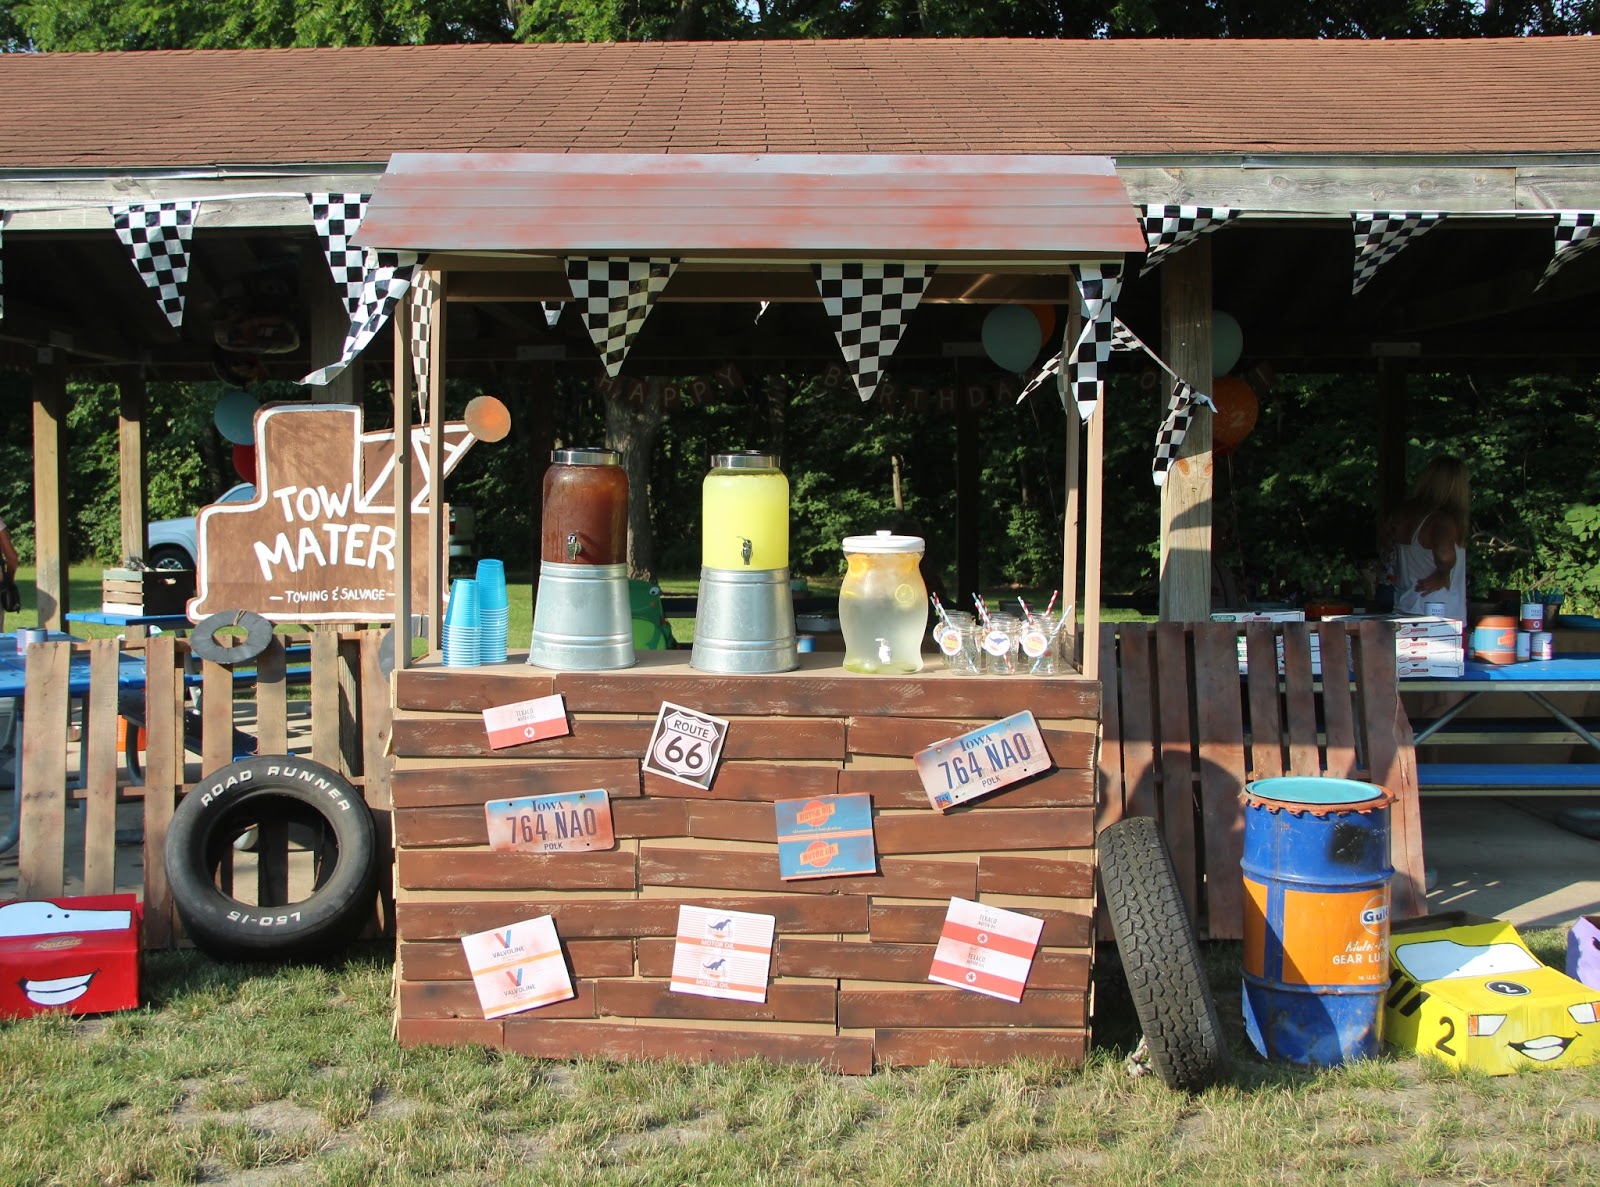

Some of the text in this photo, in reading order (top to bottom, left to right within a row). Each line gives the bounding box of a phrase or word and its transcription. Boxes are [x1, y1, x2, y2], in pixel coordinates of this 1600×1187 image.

[598, 363, 736, 407] HAPPY
[273, 482, 353, 522] TOW
[253, 523, 397, 581] MATER
[284, 590, 328, 603] TOWING
[341, 588, 385, 600] SALVAGE
[515, 708, 534, 717] TEXACO
[673, 719, 710, 739] ROUTE
[664, 735, 704, 770] 66
[937, 751, 983, 790] 764
[201, 766, 350, 811] ROAD RUNNER
[981, 775, 1002, 788] POLK
[799, 809, 821, 821] MOTOR
[821, 805, 833, 815] OIL
[506, 814, 548, 844] 764
[544, 842, 563, 851] POLK
[802, 850, 824, 862] MOTOR
[825, 846, 836, 856] OIL
[226, 910, 301, 926] L50-15
[979, 914, 998, 925] TEXACO
[1362, 908, 1388, 922] Gulf
[701, 939, 724, 949] MOTOR
[492, 945, 525, 959] VALVOLINE
[968, 953, 986, 963] TEXACO
[1332, 953, 1362, 965] GEAR
[503, 984, 537, 997] VALVOLINE
[696, 979, 719, 988] MOTOR
[1497, 984, 1518, 994] 2
[1435, 1016, 1456, 1056] 2
